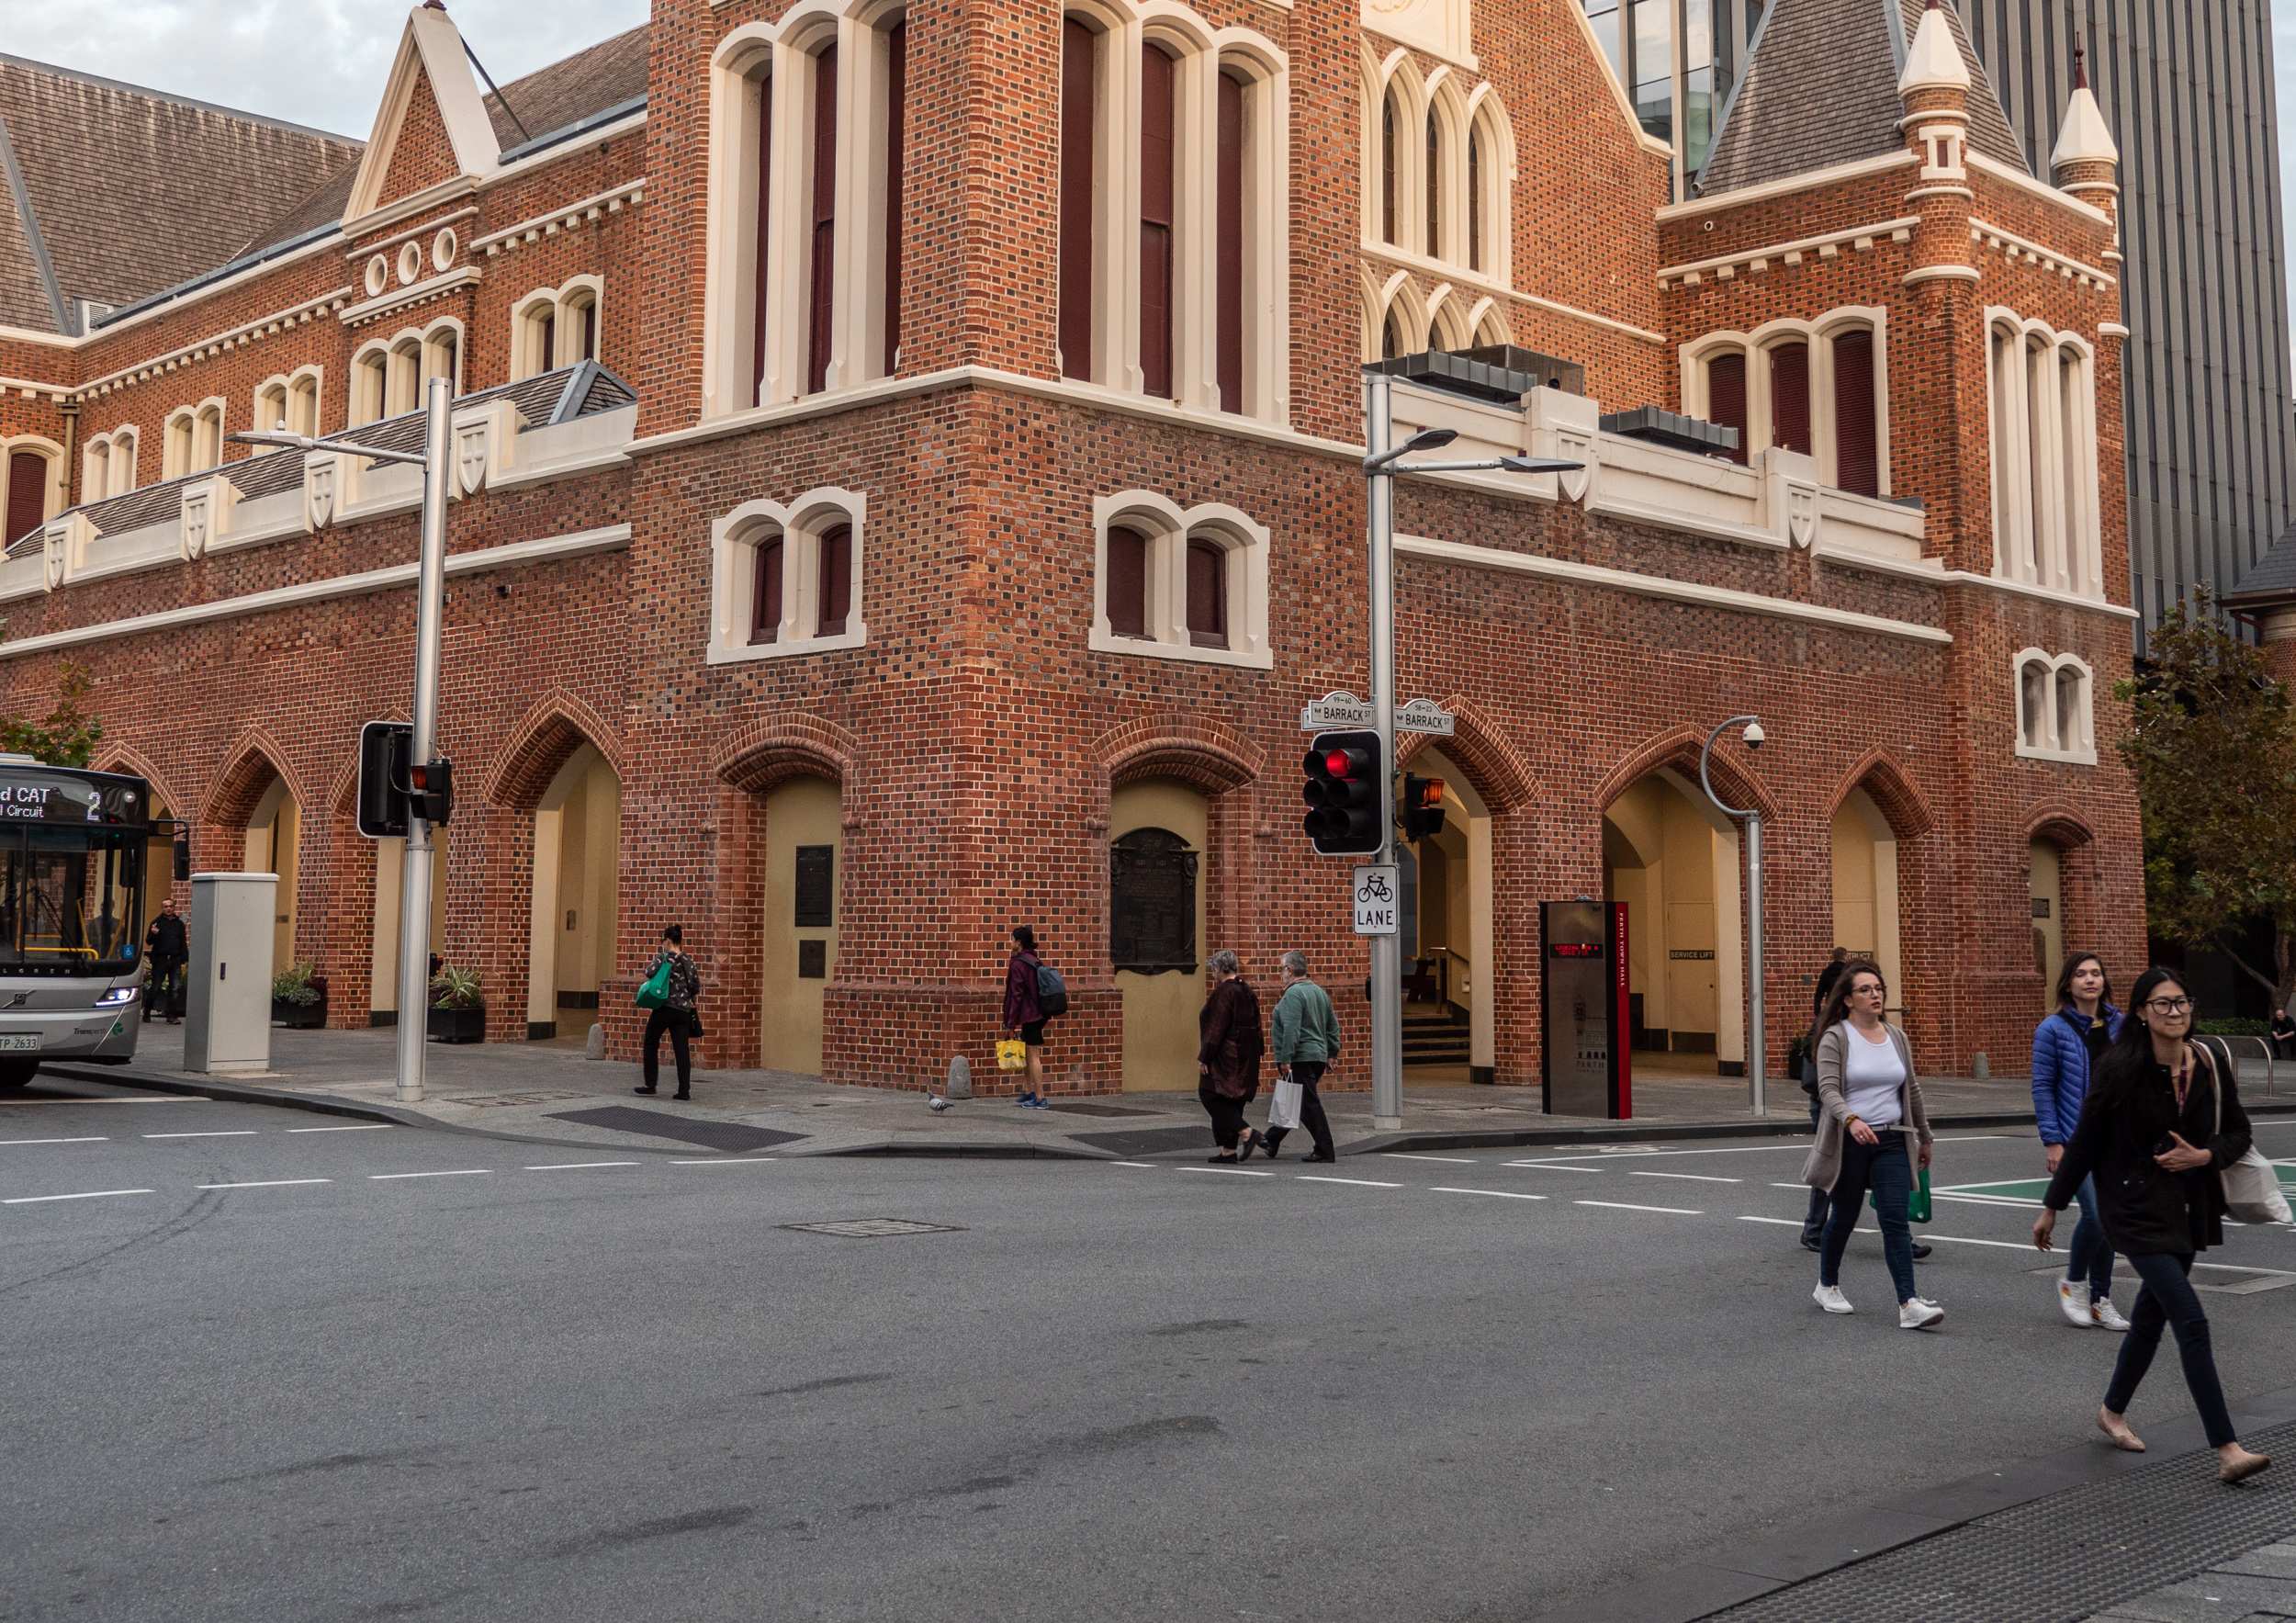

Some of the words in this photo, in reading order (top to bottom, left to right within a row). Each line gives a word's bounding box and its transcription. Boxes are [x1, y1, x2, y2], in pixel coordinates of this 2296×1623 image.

[1323, 706, 1364, 722] BARRACK
[1405, 713, 1444, 728] BARRACK
[17, 787, 51, 803] CAT
[6, 805, 45, 817] Circuit
[87, 792, 101, 820] 2
[1357, 910, 1393, 926] LANE
[1671, 951, 1698, 959] SERVICE
[1699, 951, 1713, 959] LIFT
[14, 1038, 37, 1049] 2633
